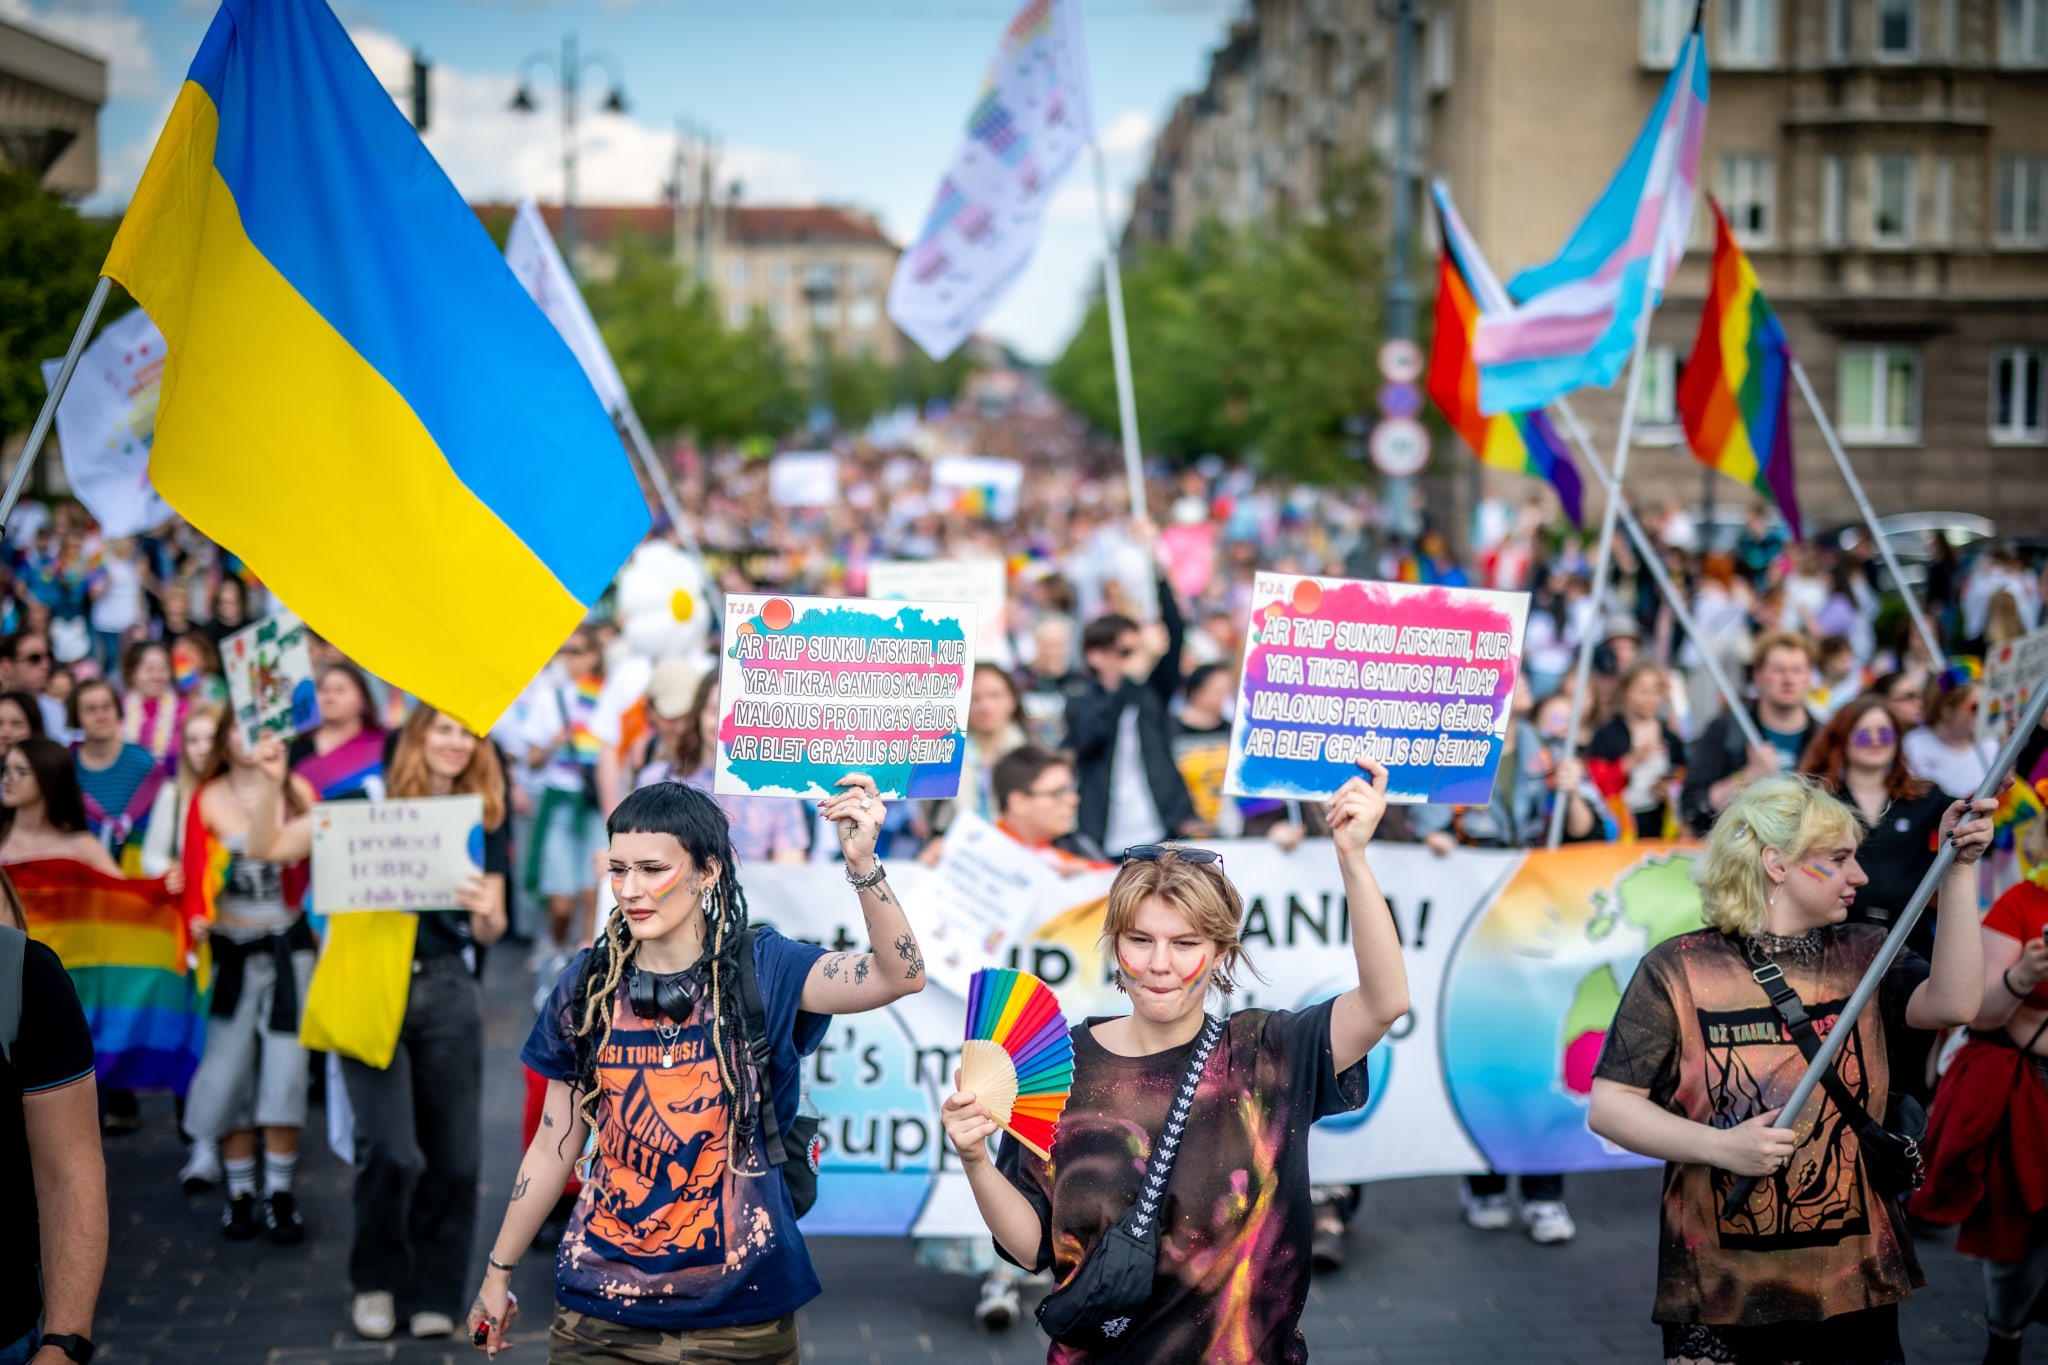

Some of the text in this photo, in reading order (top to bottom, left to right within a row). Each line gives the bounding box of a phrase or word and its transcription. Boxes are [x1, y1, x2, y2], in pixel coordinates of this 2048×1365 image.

[1258, 583, 1285, 596] TJA
[728, 603, 755, 615] TJA
[737, 634, 965, 667] AR TAIP SUNKU ATSKIRTI, KUR
[1262, 616, 1510, 662] AR TAIP SUNKU ATSKIRTI, KUR
[743, 668, 958, 698] YRA TIKRA GAMTOS KLAIDA?
[1266, 654, 1498, 695] YRA TIKRA GAMTOS KLAIDA?
[735, 701, 956, 733] MALONUS PROTINGAS GĖJUS,
[1253, 691, 1494, 735] MALONUS PROTINGAS GĖJUS,
[731, 735, 954, 764] AR BLET GRAŽULIS SU ŠEIMA?
[1246, 728, 1490, 765] AR BLET GRAŽULIS SU ŠEIMA?
[626, 1046, 664, 1064] TURI
[815, 1027, 881, 1083] t's
